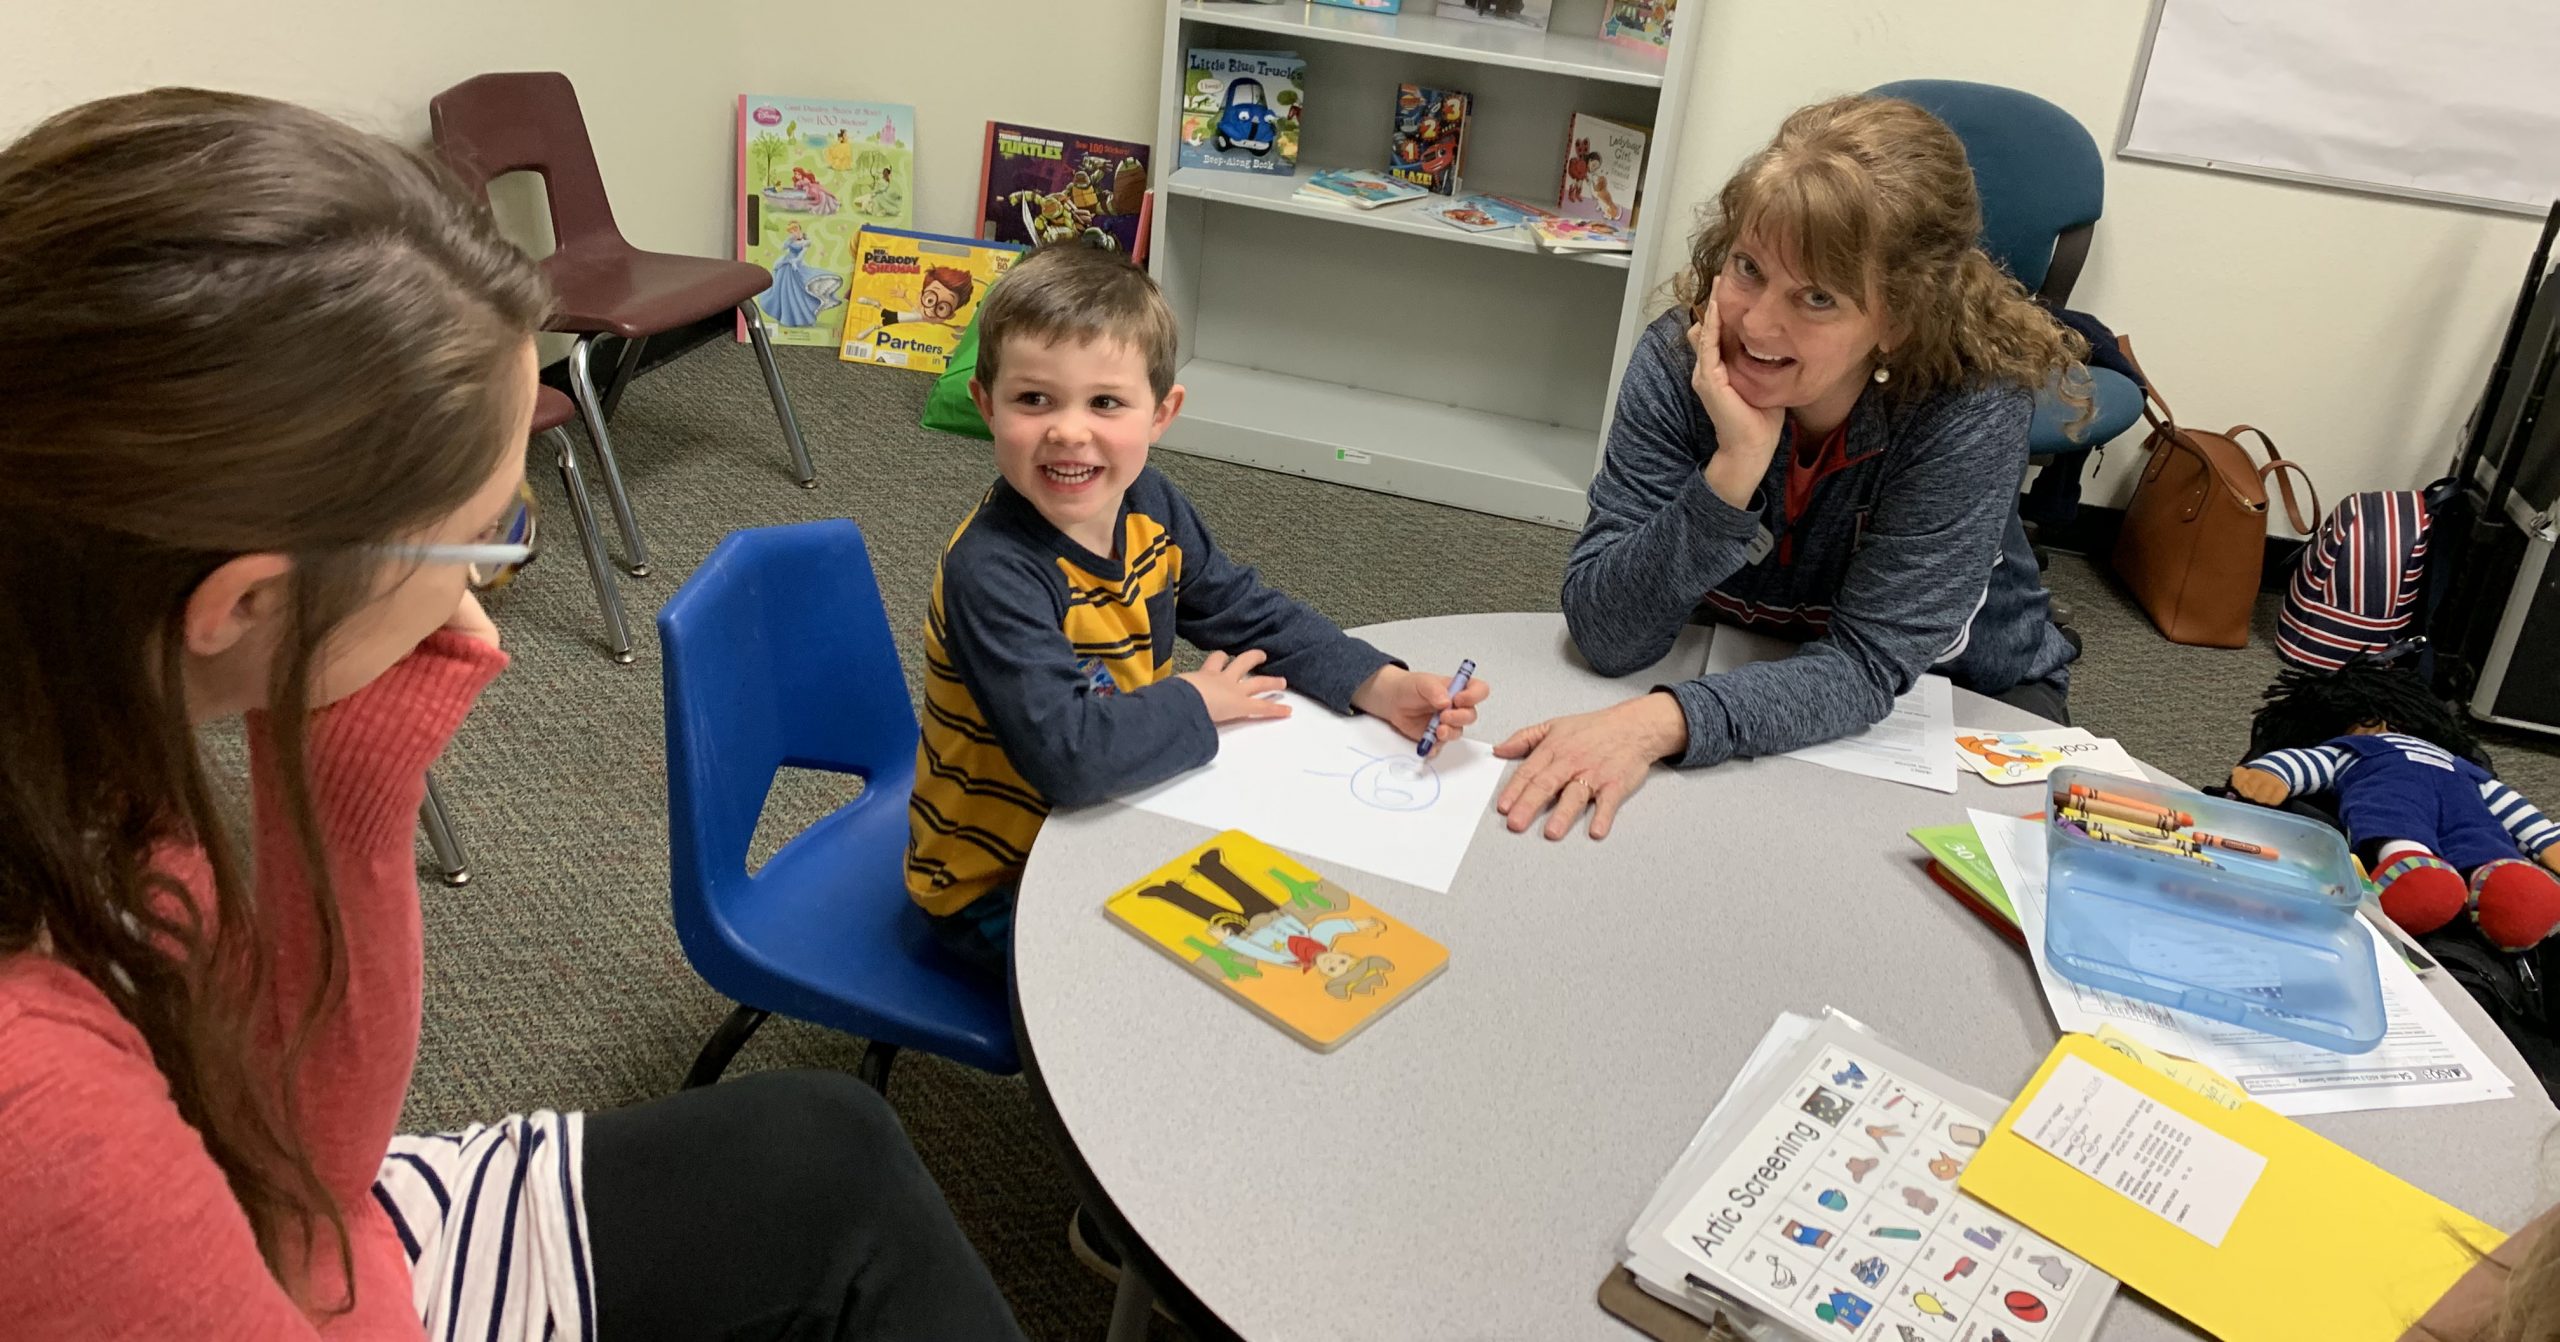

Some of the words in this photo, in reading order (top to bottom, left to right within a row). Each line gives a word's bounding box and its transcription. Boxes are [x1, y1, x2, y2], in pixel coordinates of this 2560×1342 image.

[1190, 54, 1226, 71] Little
[1228, 58, 1255, 73] Blue
[1447, 98, 1461, 121] 3
[816, 115, 838, 126] 100
[1423, 118, 1437, 139] 2
[998, 139, 1063, 160] TURTLES
[1089, 142, 1104, 154] 100
[1403, 142, 1416, 161] 1
[1609, 135, 1642, 155] Ladybug
[1203, 155, 1252, 169] Beep-Along
[1252, 159, 1275, 170] Book
[864, 252, 920, 266] PEABODY
[876, 331, 944, 355] Partners
[932, 357, 941, 366] in
[2052, 743, 2099, 757] cook
[2398, 1071, 2413, 1080] 54
[1691, 1207, 1743, 1259] Artic
[1728, 1120, 1821, 1209] Screening
